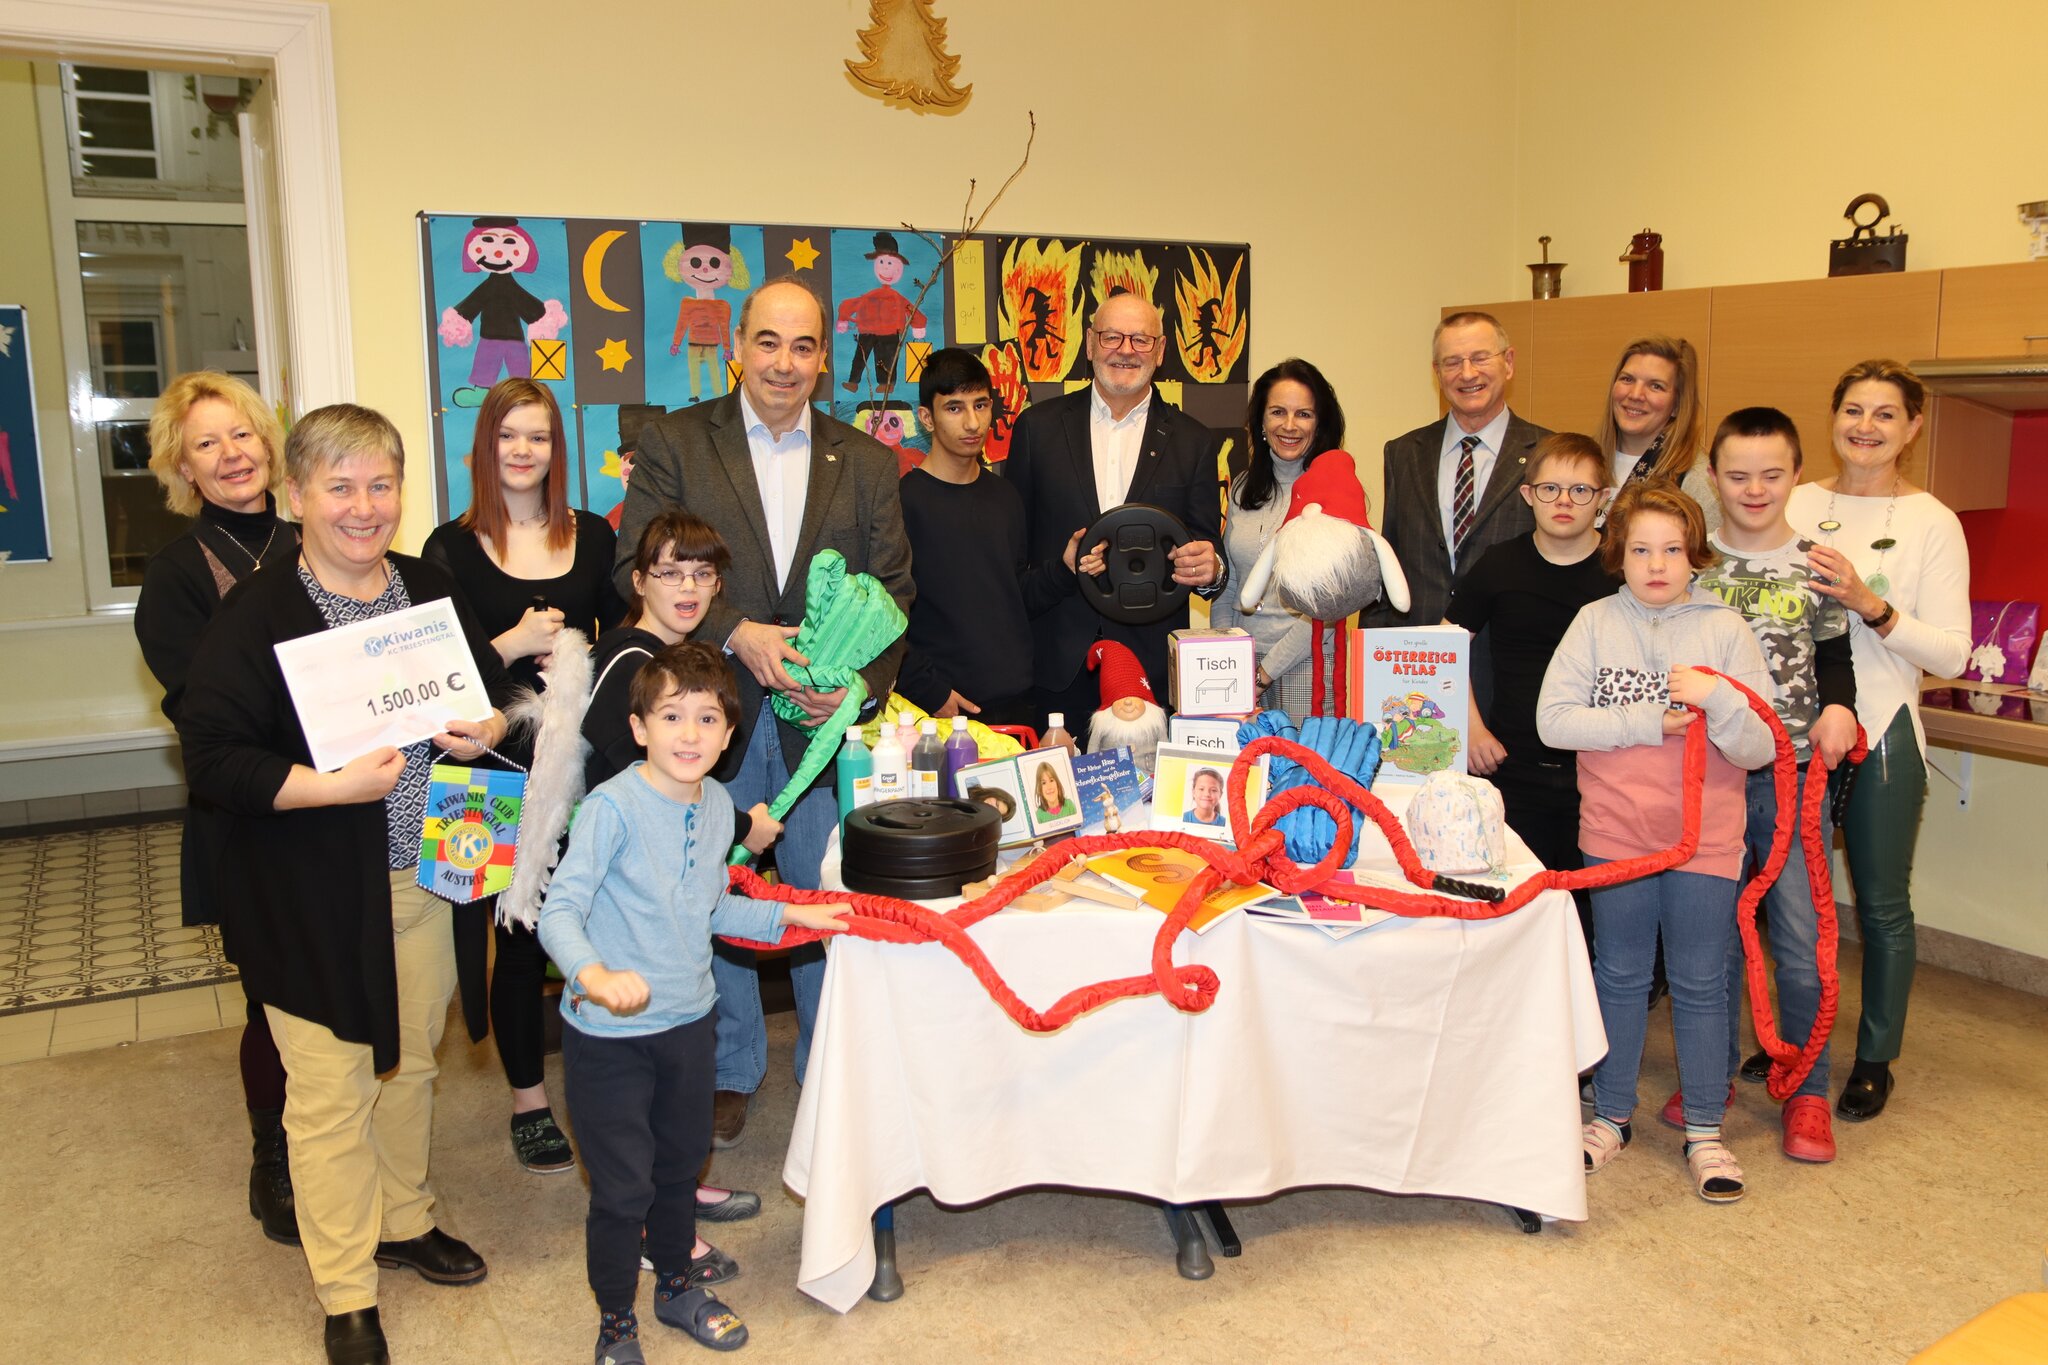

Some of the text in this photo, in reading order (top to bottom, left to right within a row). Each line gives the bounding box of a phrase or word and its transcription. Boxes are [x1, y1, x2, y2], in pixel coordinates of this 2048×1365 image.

[956, 251, 976, 264] Ach
[960, 282, 976, 291] wie
[382, 620, 449, 647] Kiwanis
[387, 631, 456, 656] KC TRIESTINGTAL
[1196, 656, 1237, 671] Tisch
[1374, 645, 1457, 664] ÖSTERREICH
[1392, 663, 1437, 677] ATLAS
[367, 671, 466, 717] 1.500,00 €
[1187, 735, 1225, 749] Fisch
[1077, 766, 1087, 774] Der
[436, 792, 515, 820] KIWANIS CLUB
[435, 806, 507, 836] TRIESTINGTAL
[440, 869, 488, 887] AUSTRIA
